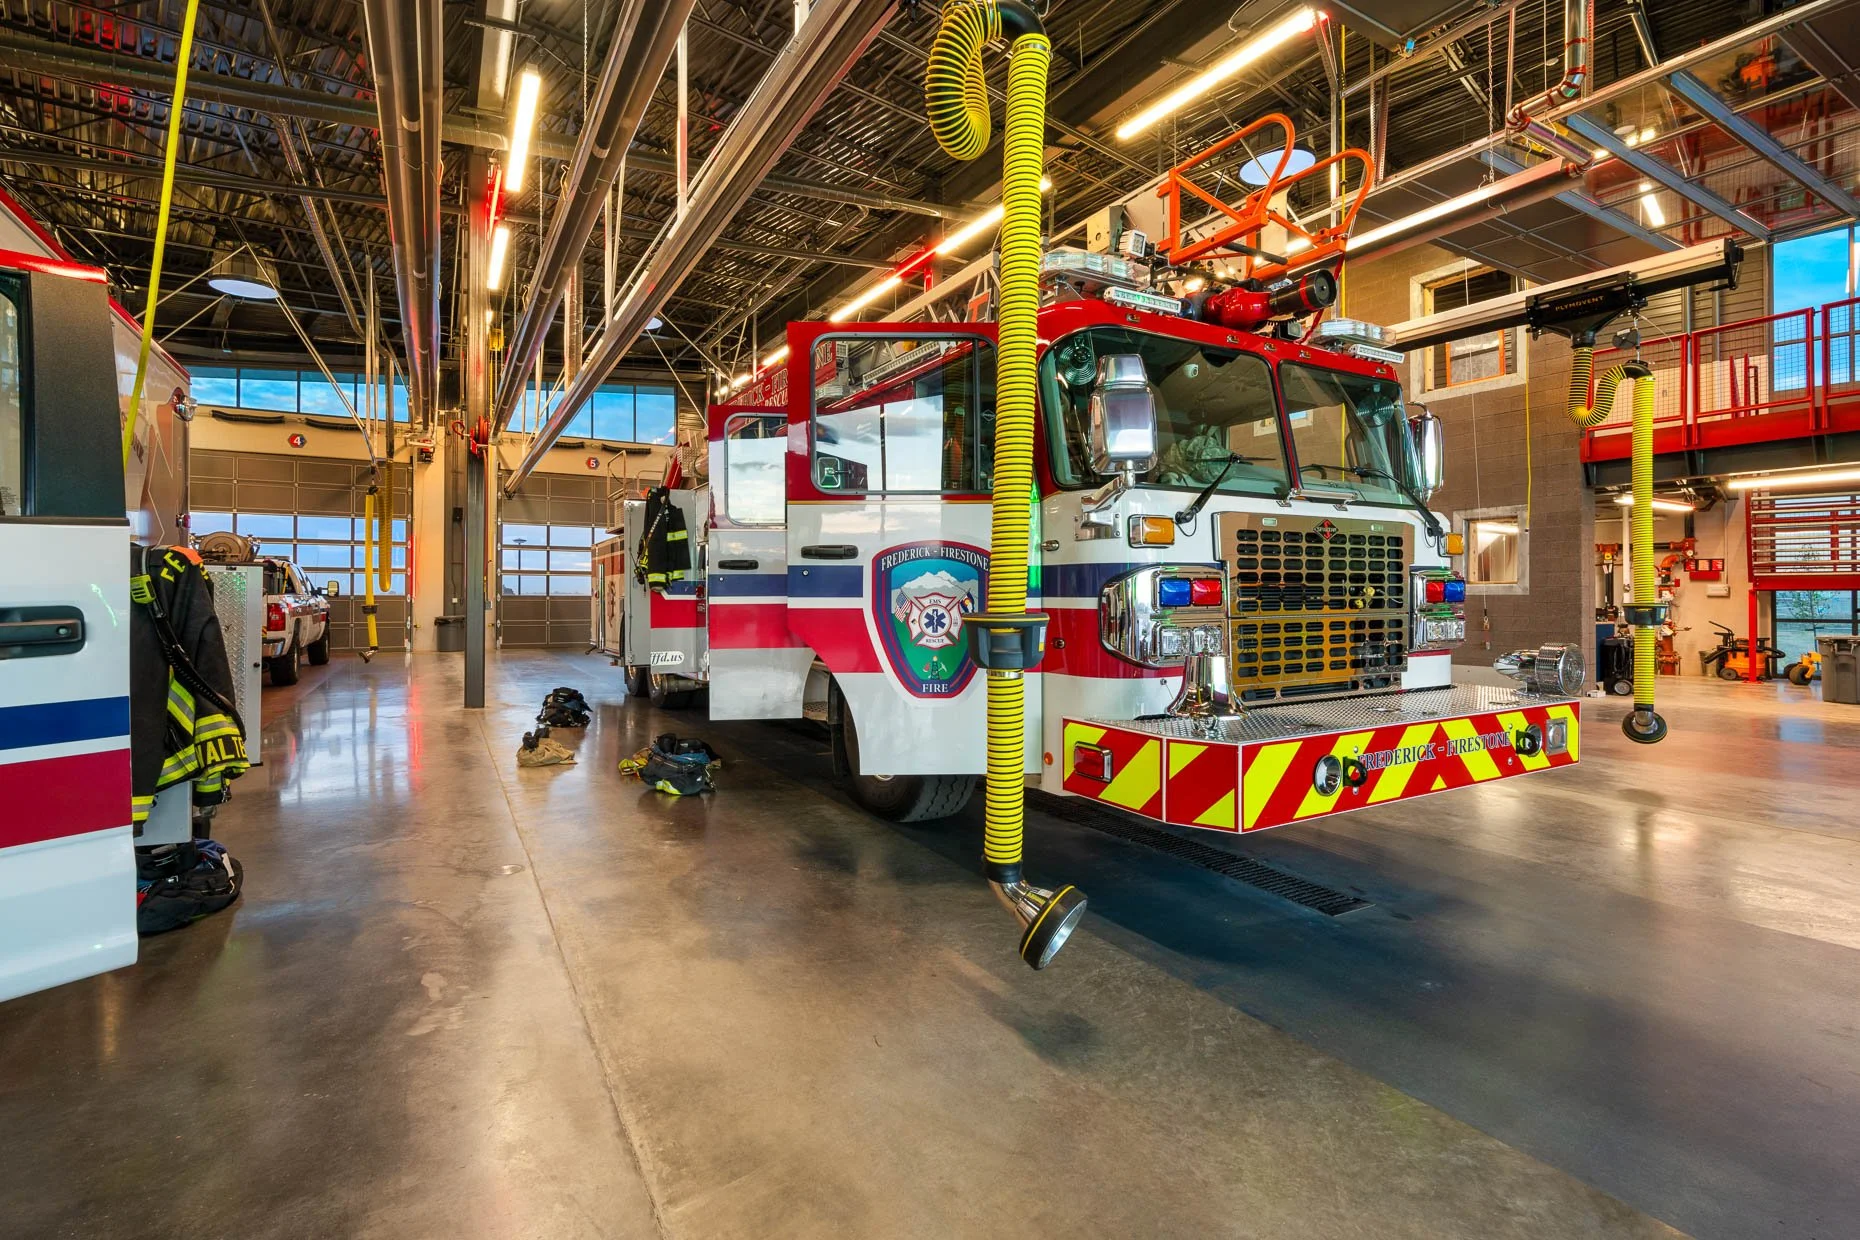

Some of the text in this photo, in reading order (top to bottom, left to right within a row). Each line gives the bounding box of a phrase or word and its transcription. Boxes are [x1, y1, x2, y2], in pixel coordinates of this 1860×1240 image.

[1555, 295, 1604, 312] PLYMOVENT
[293, 436, 302, 446] 4
[881, 547, 931, 571] FREDERICK
[940, 547, 990, 571] FIRESTONE
[922, 683, 949, 693] FIRE
[1356, 742, 1436, 772] FREDERICK
[1446, 731, 1511, 758] FIRESTONE
